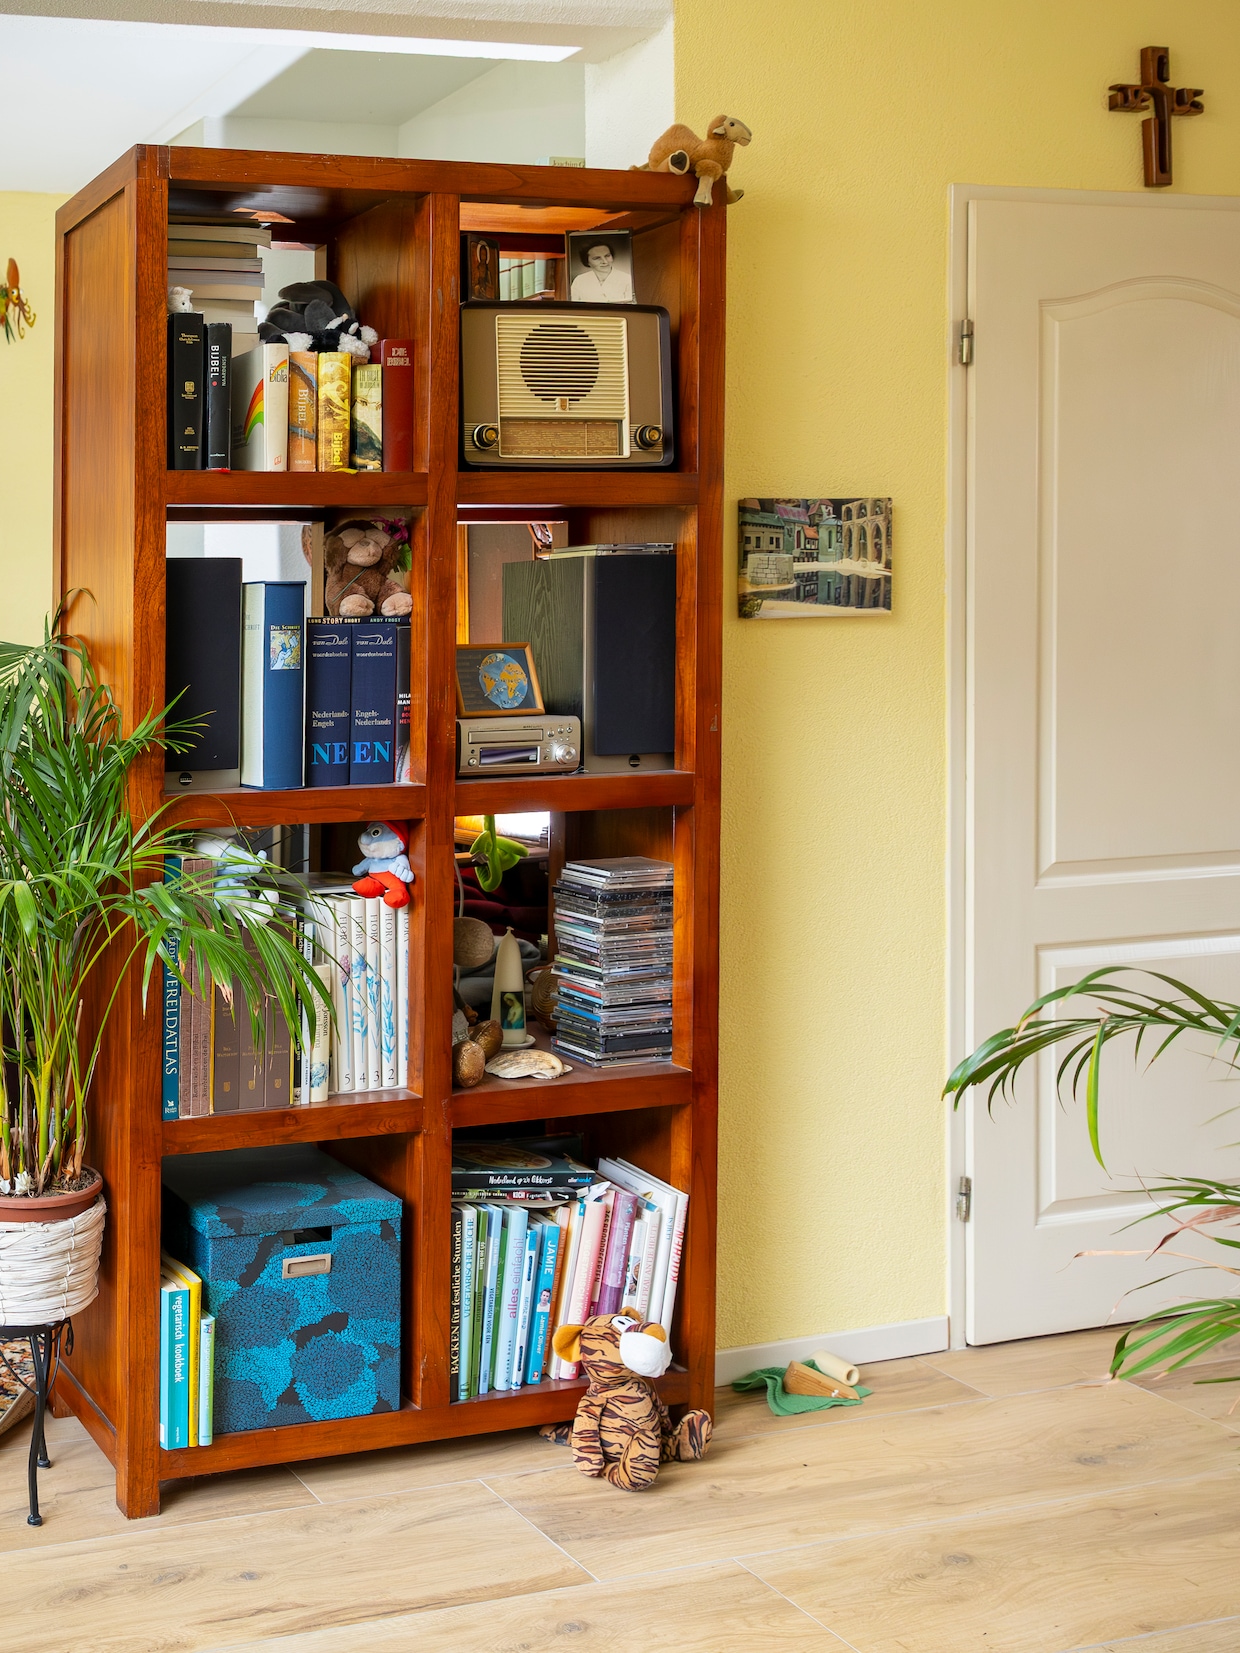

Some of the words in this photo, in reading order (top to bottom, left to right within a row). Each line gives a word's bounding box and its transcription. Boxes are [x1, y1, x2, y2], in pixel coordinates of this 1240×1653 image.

[210, 345, 220, 378] BIJBEL
[297, 388, 309, 424] BIJBEL
[331, 432, 344, 467] Bijbel
[322, 617, 343, 625] STORY
[312, 711, 349, 719] Nederlands-
[312, 720, 334, 728] Engels
[355, 710, 379, 718] Engels-
[355, 718, 391, 726] Nederlands
[311, 742, 348, 765] NE
[352, 741, 391, 764] EN
[340, 916, 348, 947] FLORA
[355, 915, 363, 946] FLORA
[370, 914, 378, 945] FLORA
[385, 912, 393, 943] FLORA
[344, 1073, 351, 1085] 5
[359, 1072, 366, 1083] 4
[373, 1070, 380, 1082] 3
[387, 1068, 394, 1080] 2
[452, 1221, 462, 1263] Stunden
[464, 1218, 474, 1249] KÜCHE
[622, 1221, 631, 1245] Planten
[510, 1238, 524, 1285] einfach!
[544, 1240, 557, 1275] JAMIE
[578, 1239, 592, 1300] VEGETARISCH
[670, 1230, 684, 1283] KOCHEN
[451, 1265, 461, 1306] festliche
[464, 1251, 473, 1318] VEGETARISCHE
[641, 1275, 651, 1298] FRAU
[172, 1294, 185, 1340] vegetarisch
[451, 1308, 460, 1323] für
[507, 1288, 518, 1319] alles
[450, 1326, 460, 1374] BACKEN
[536, 1335, 545, 1354] Oliver
[174, 1343, 185, 1383] kookboek
